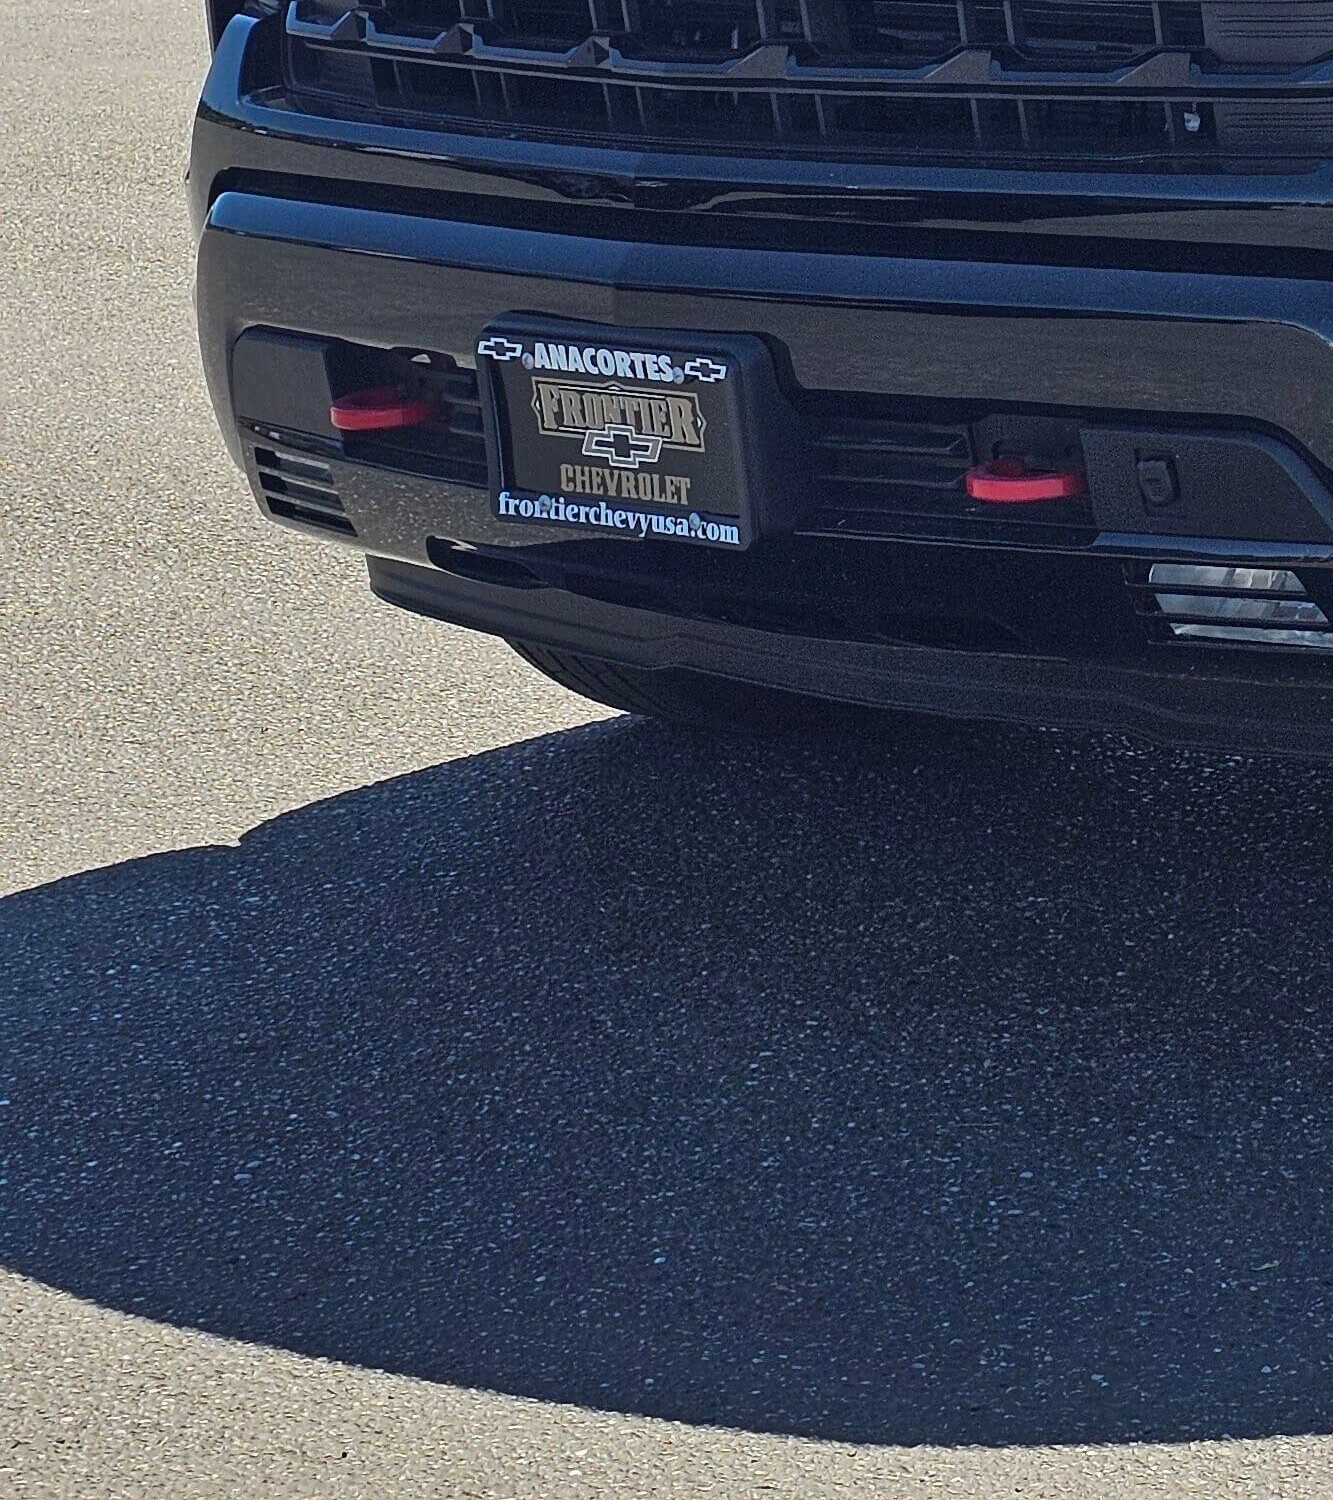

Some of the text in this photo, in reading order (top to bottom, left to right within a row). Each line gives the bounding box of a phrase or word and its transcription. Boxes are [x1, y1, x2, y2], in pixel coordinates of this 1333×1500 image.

[534, 342, 674, 382] ANACORTES
[538, 382, 700, 445] FRONTIER
[559, 463, 691, 506] CHEVROLET
